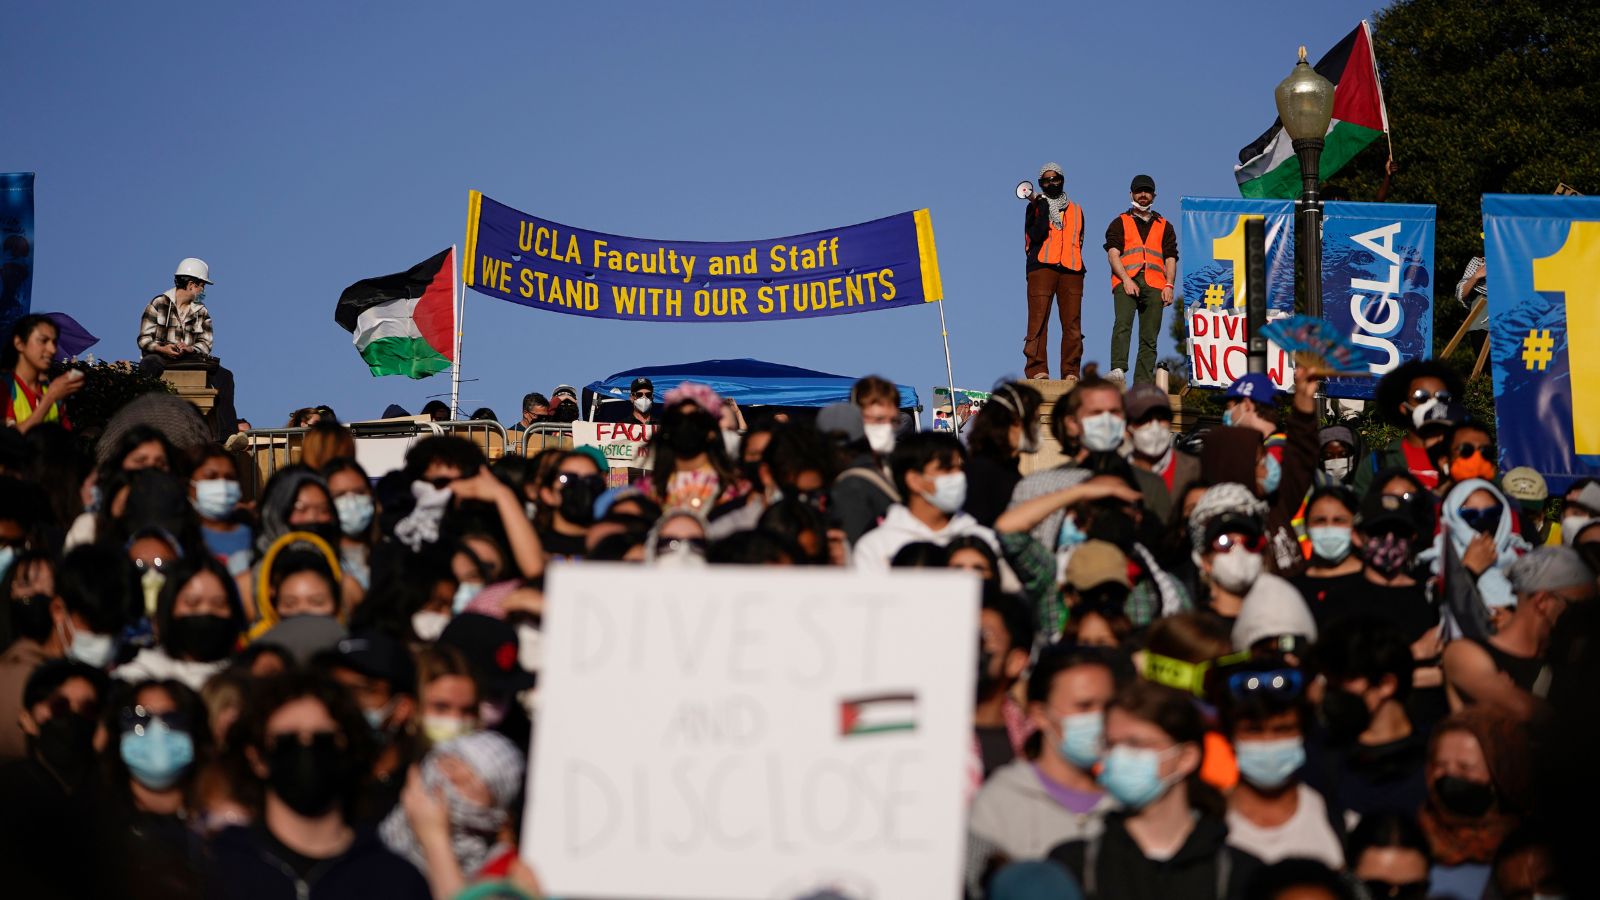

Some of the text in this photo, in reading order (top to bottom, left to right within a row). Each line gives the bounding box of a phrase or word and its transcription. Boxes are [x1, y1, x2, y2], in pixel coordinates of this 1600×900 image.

[518, 220, 840, 283] UCLA Faculty and Staff
[482, 255, 897, 317] WE STAND WITH OUR STUDENTS
[1350, 221, 1402, 375] UCLA
[1236, 382, 1254, 396] 42
[570, 589, 907, 690] DIVEST
[660, 693, 771, 751] AND
[563, 748, 936, 863] DISCLOSE
